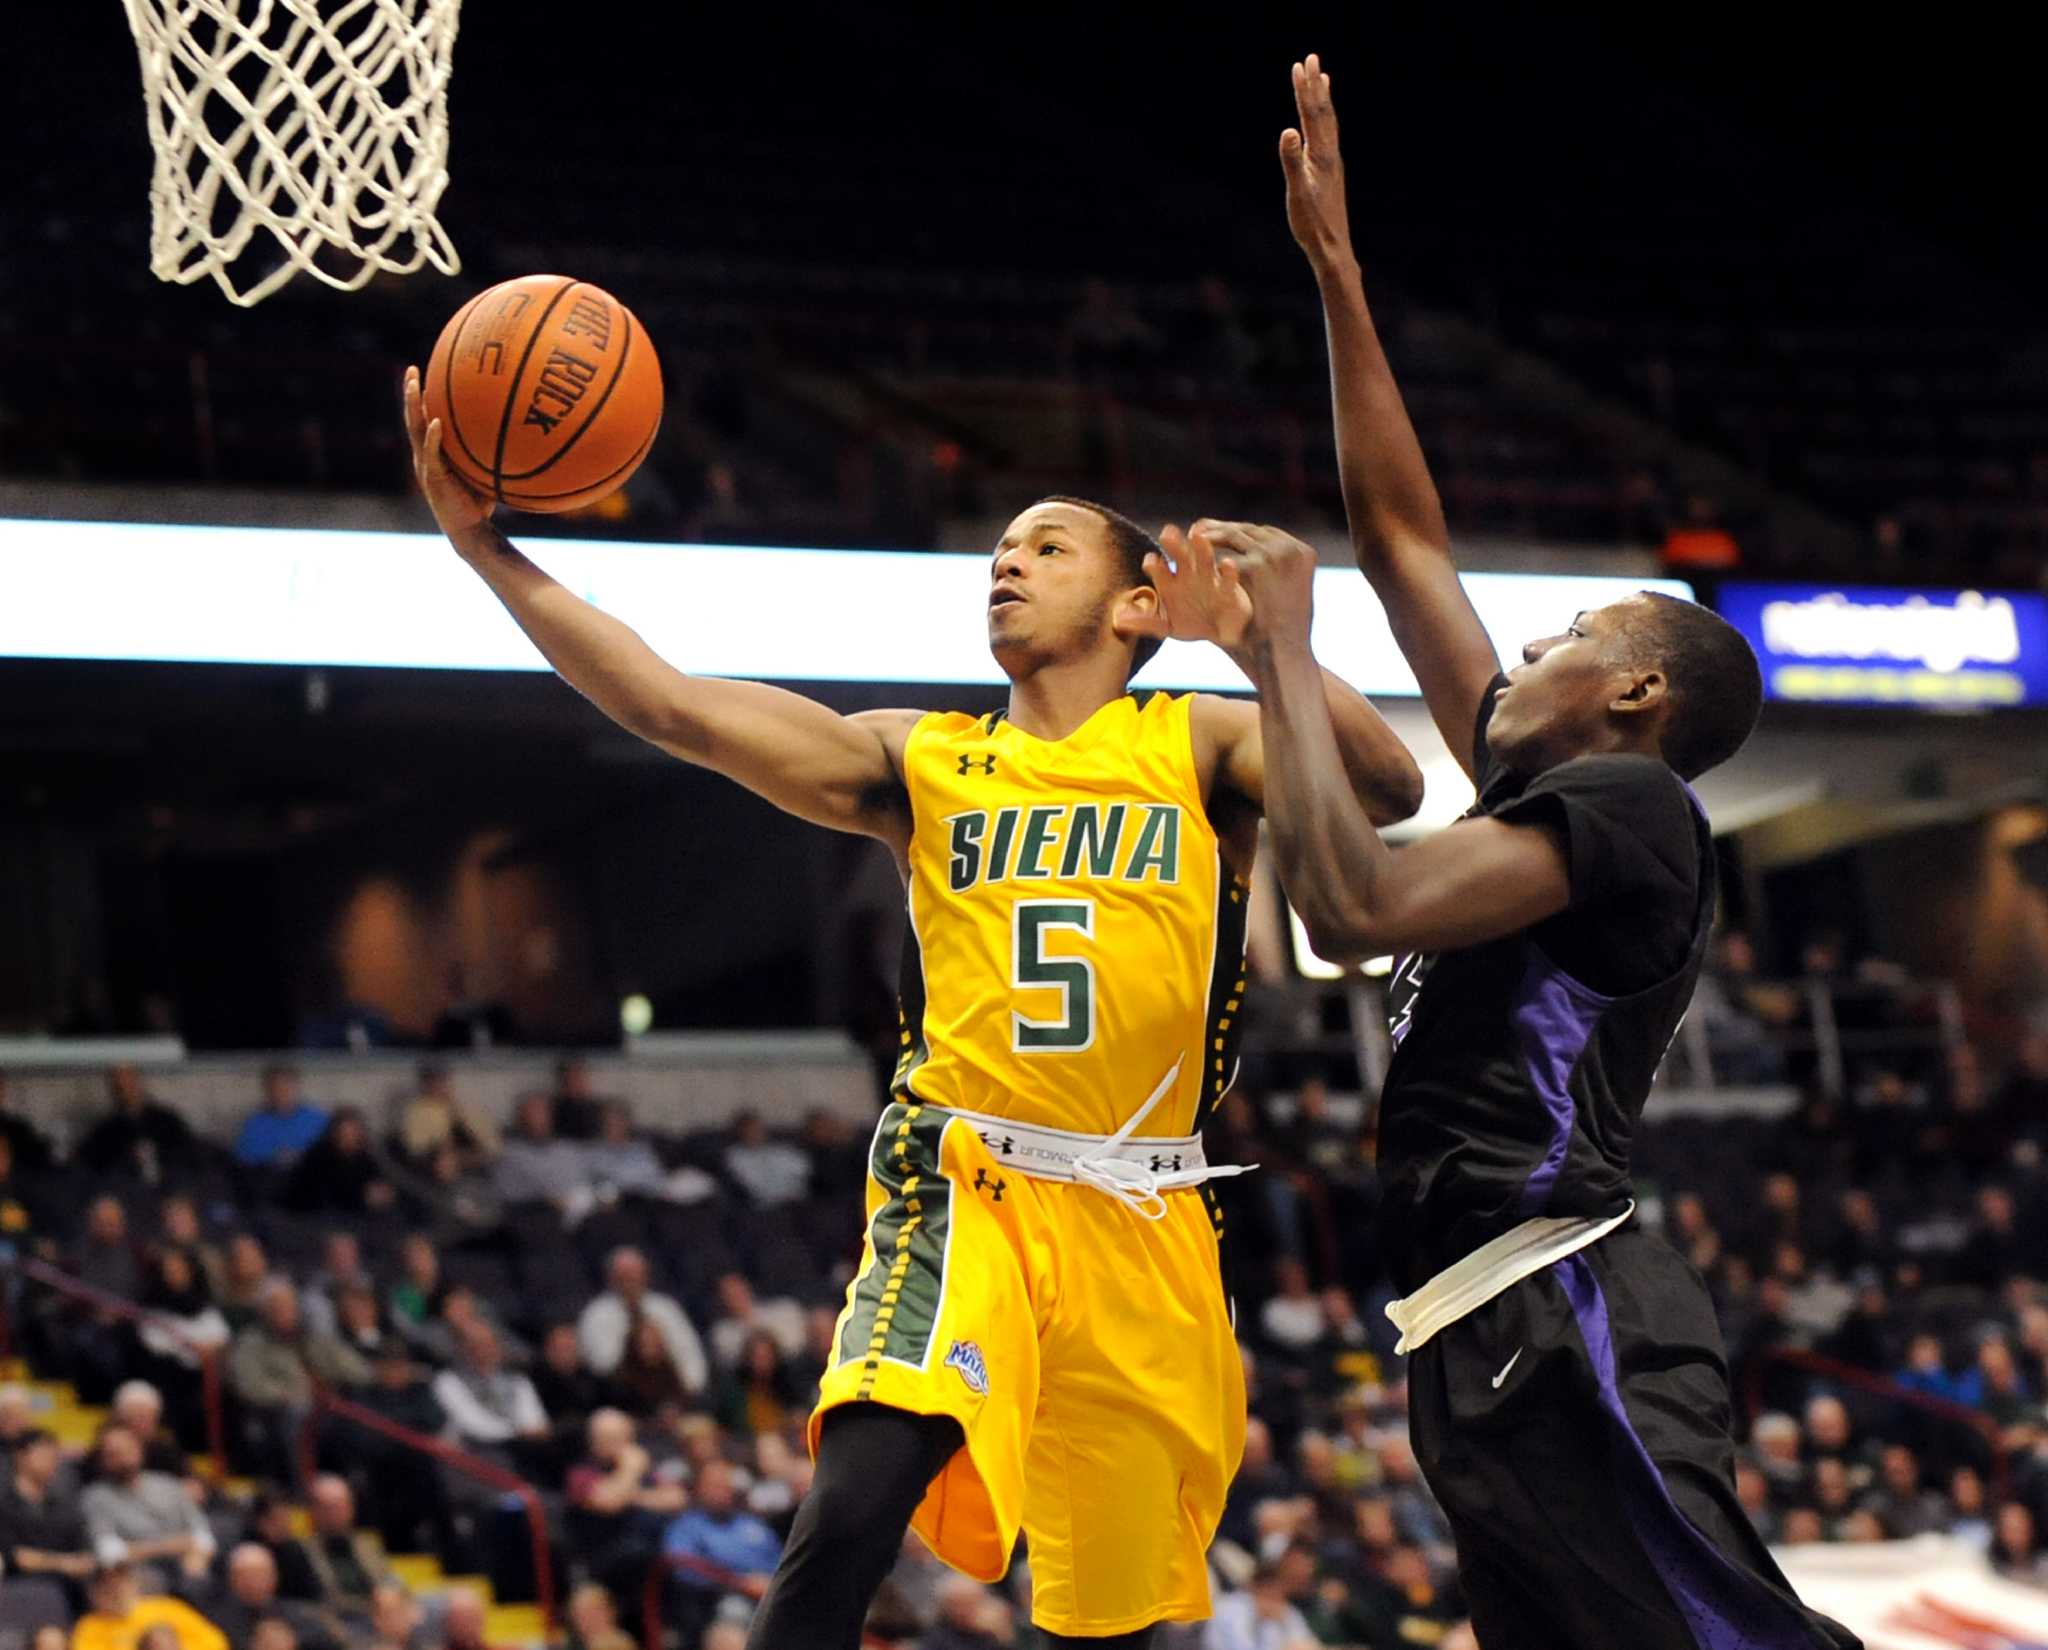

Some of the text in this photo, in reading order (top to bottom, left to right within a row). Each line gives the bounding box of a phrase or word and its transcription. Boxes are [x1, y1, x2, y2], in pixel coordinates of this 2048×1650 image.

[524, 294, 612, 434] THE ROCK
[942, 801, 1183, 894] SIENA
[1012, 898, 1096, 1054] 5
